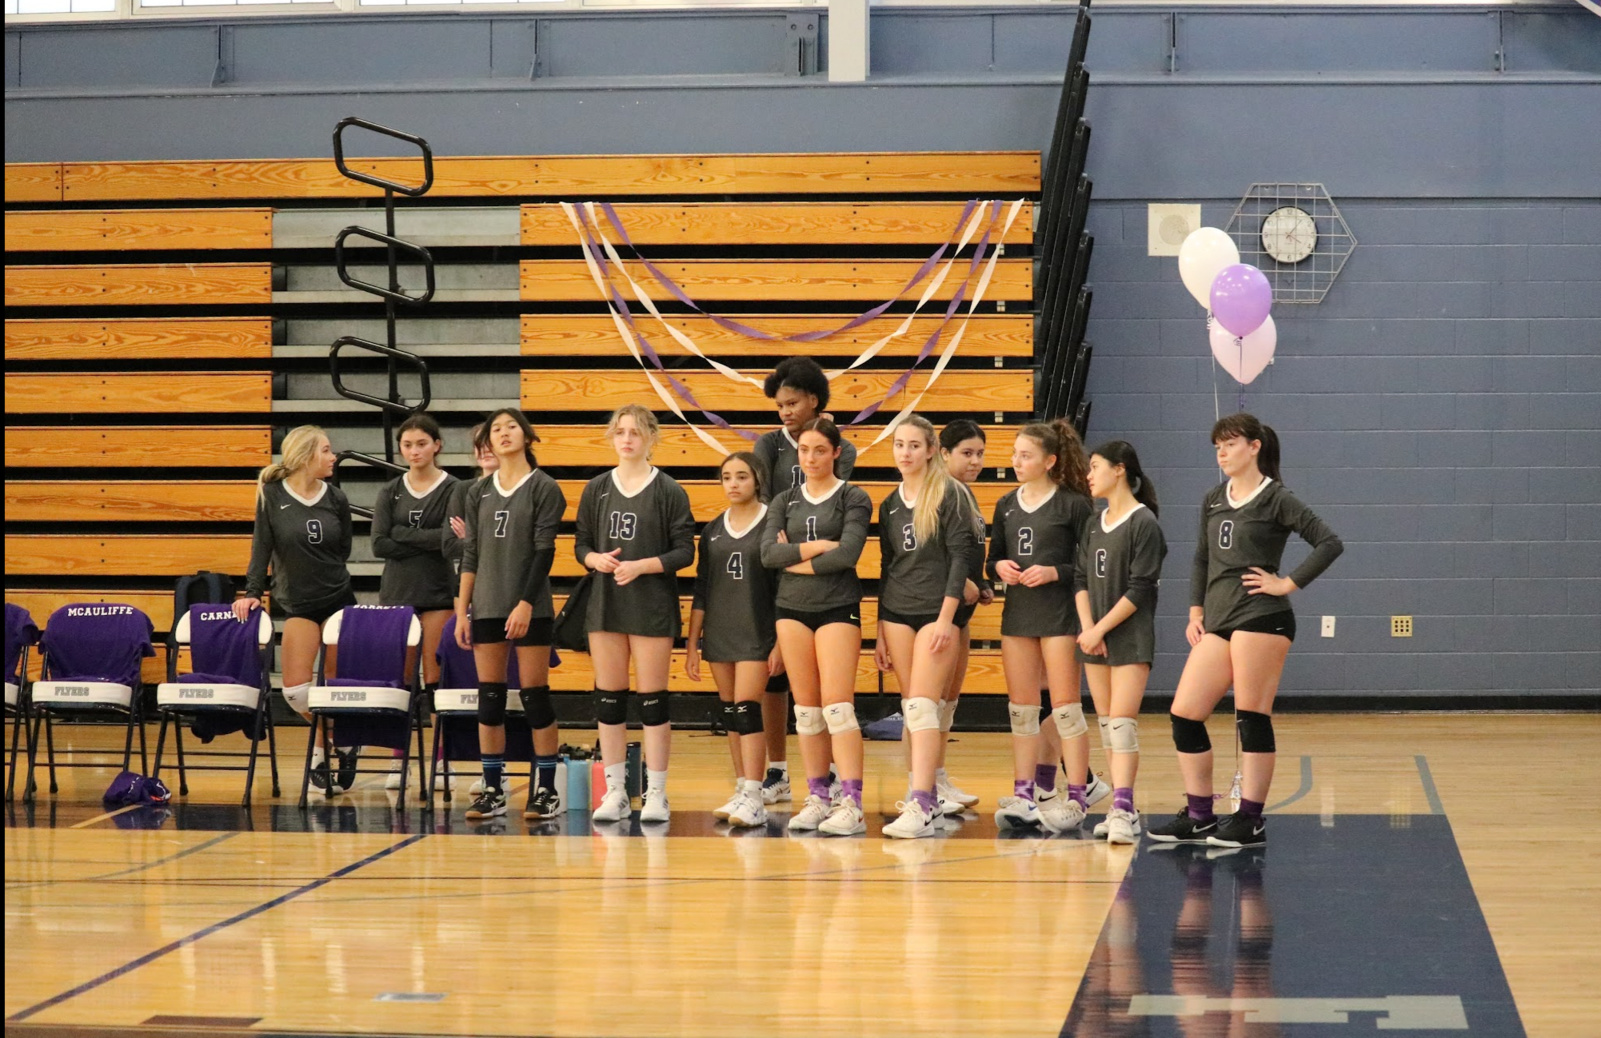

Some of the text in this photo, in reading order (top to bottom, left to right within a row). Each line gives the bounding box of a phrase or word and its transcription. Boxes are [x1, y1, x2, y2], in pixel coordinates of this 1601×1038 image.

[306, 519, 323, 544] 9
[495, 511, 509, 537] 7
[609, 511, 637, 540] 13
[806, 516, 817, 542] 1
[1218, 520, 1234, 549] 8
[903, 524, 917, 551] 3
[1018, 527, 1033, 556] 2
[727, 552, 743, 580] 4
[67, 606, 134, 617] MCAULIFFE
[200, 611, 238, 621] CARN
[54, 686, 90, 697] FLYERS
[179, 688, 214, 698] FLYERS
[330, 691, 367, 702] FLYERS
